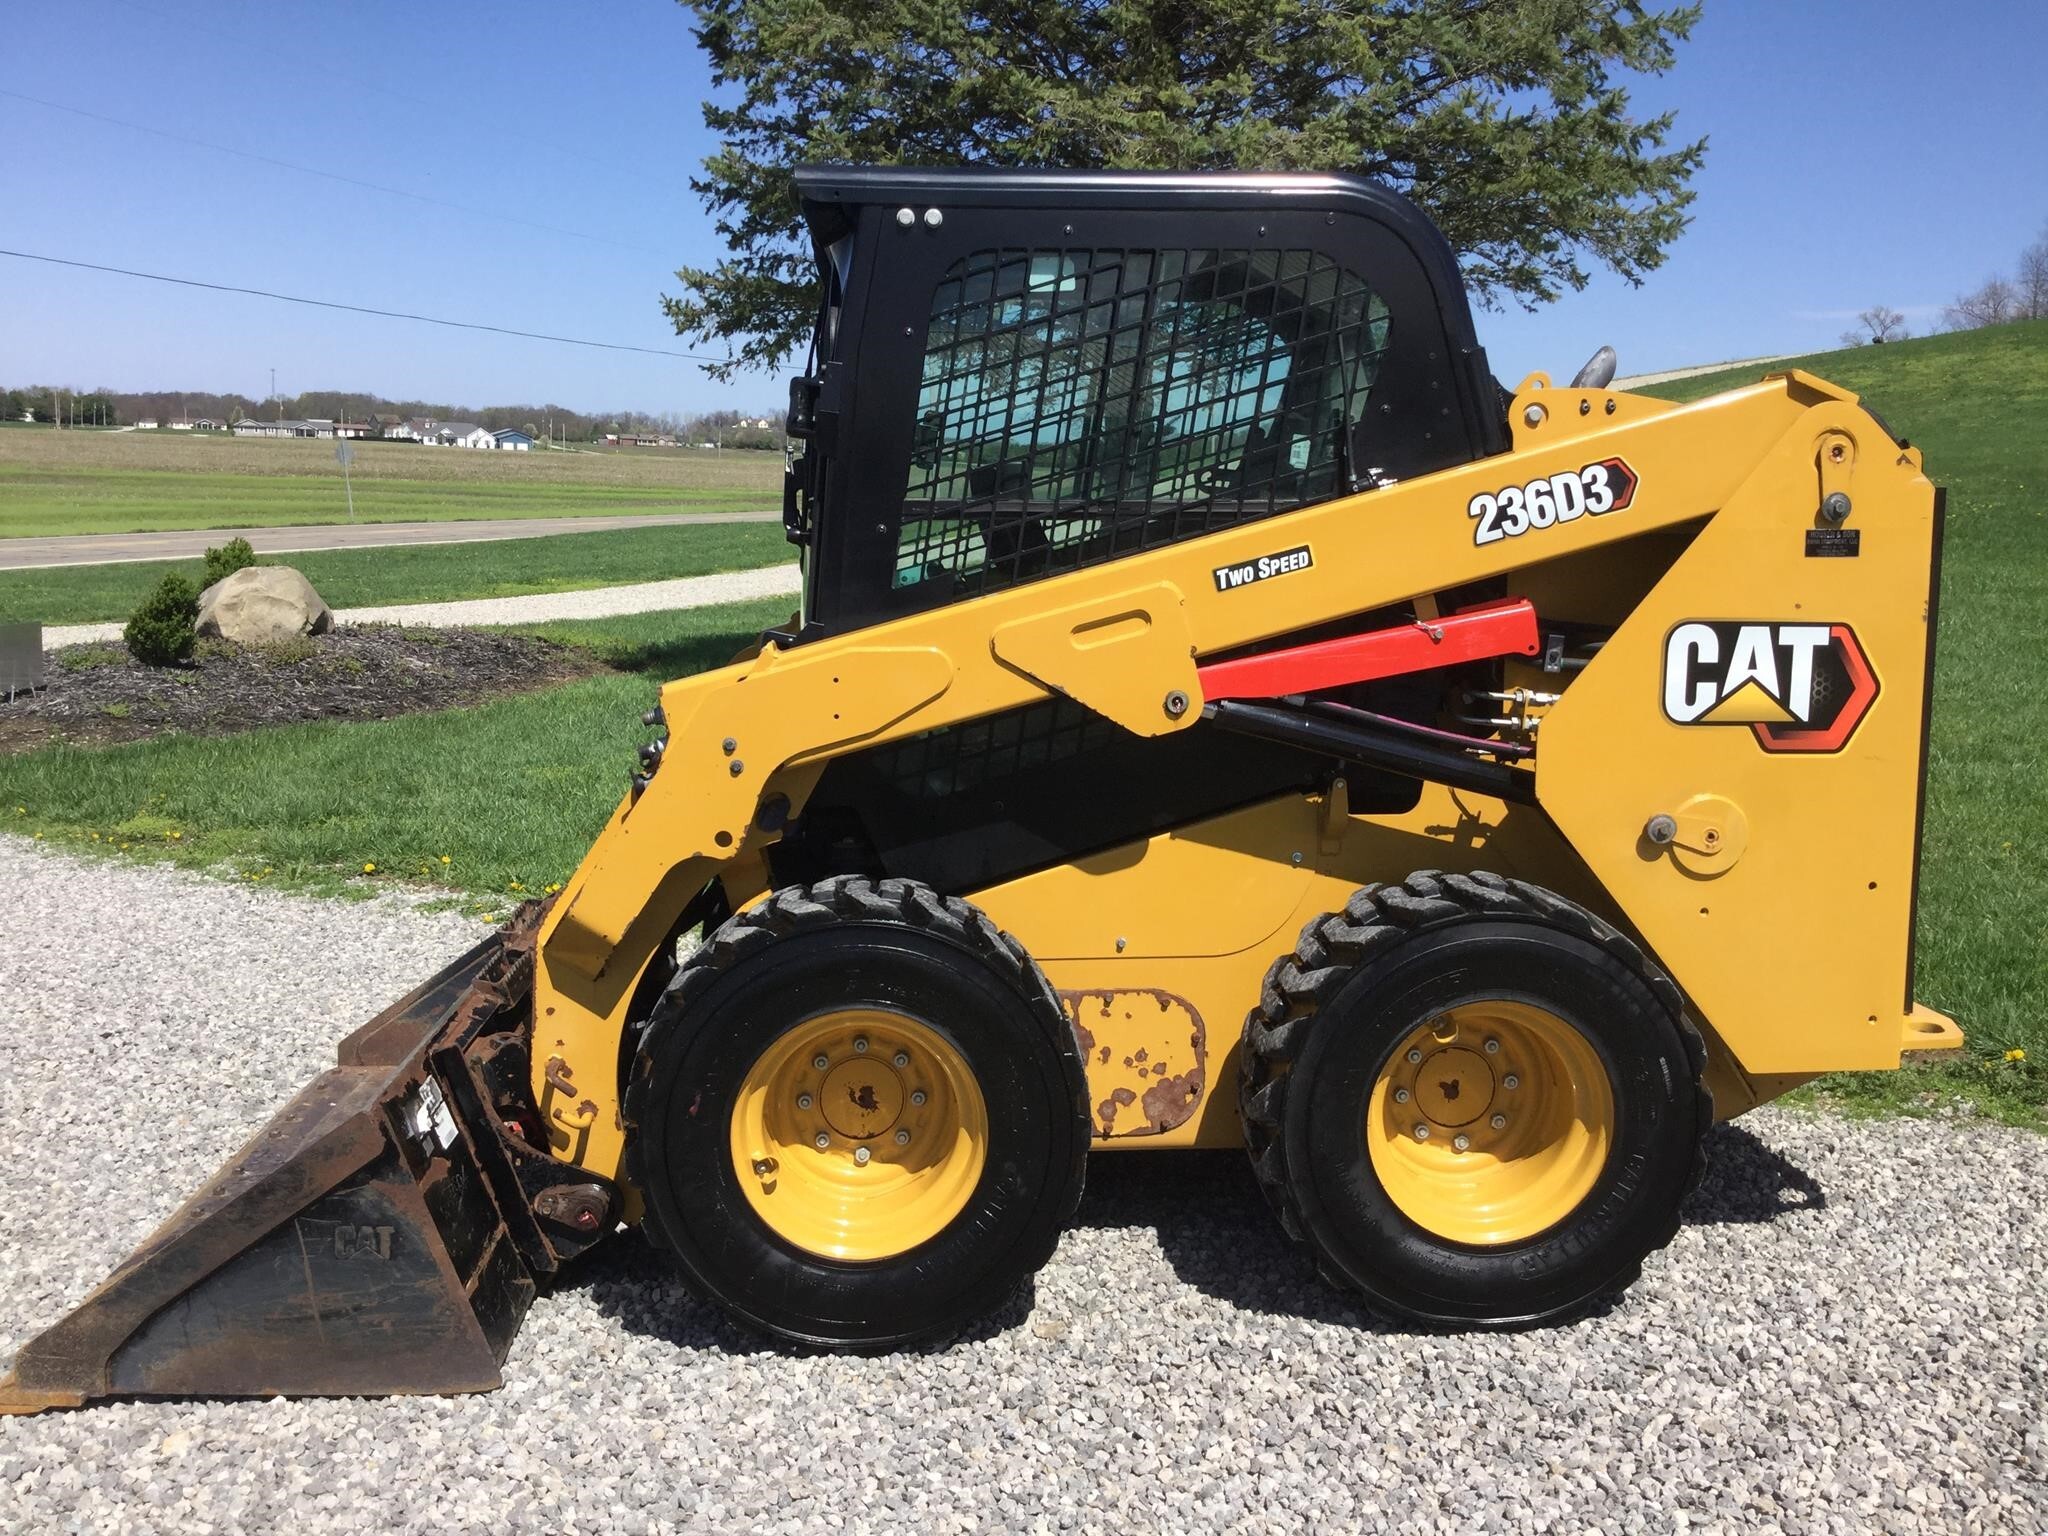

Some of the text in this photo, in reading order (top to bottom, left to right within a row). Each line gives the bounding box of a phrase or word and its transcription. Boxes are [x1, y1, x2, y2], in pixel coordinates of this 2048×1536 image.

[1469, 464, 1614, 545] 236D3
[1216, 551, 1309, 590] TWO SPEED
[1665, 623, 1830, 723] CAT
[335, 1225, 395, 1260] CAT
